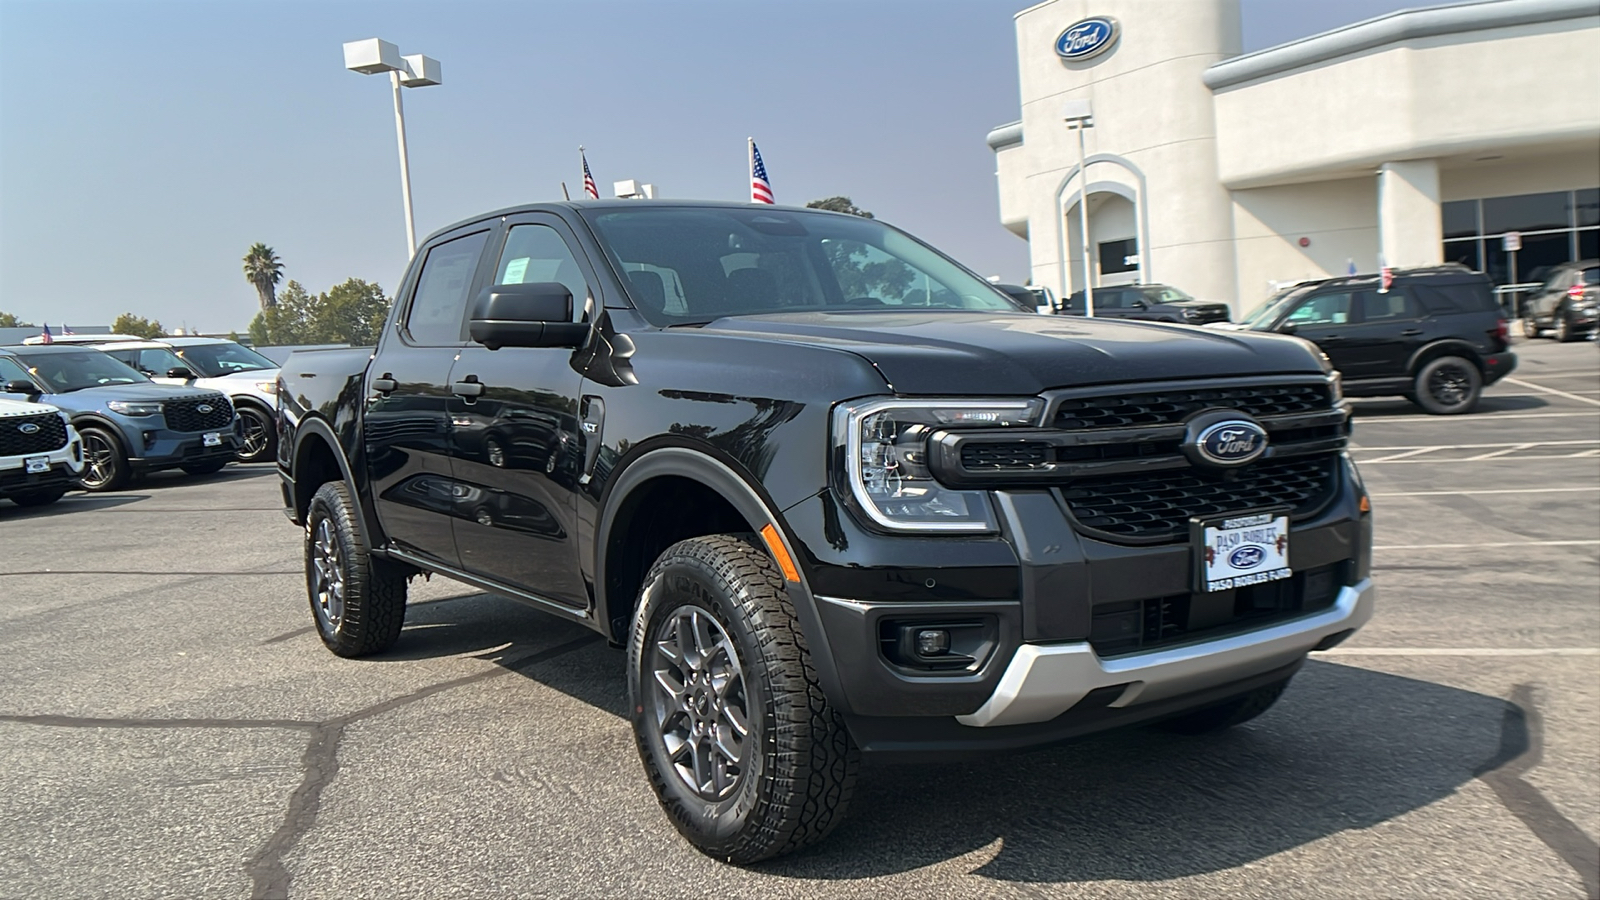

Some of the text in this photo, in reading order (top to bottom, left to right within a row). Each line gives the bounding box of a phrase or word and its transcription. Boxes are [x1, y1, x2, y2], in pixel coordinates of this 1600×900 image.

[1064, 25, 1100, 53] Ford
[1217, 430, 1255, 454] Ford
[1216, 527, 1277, 555] PASO ROBLES
